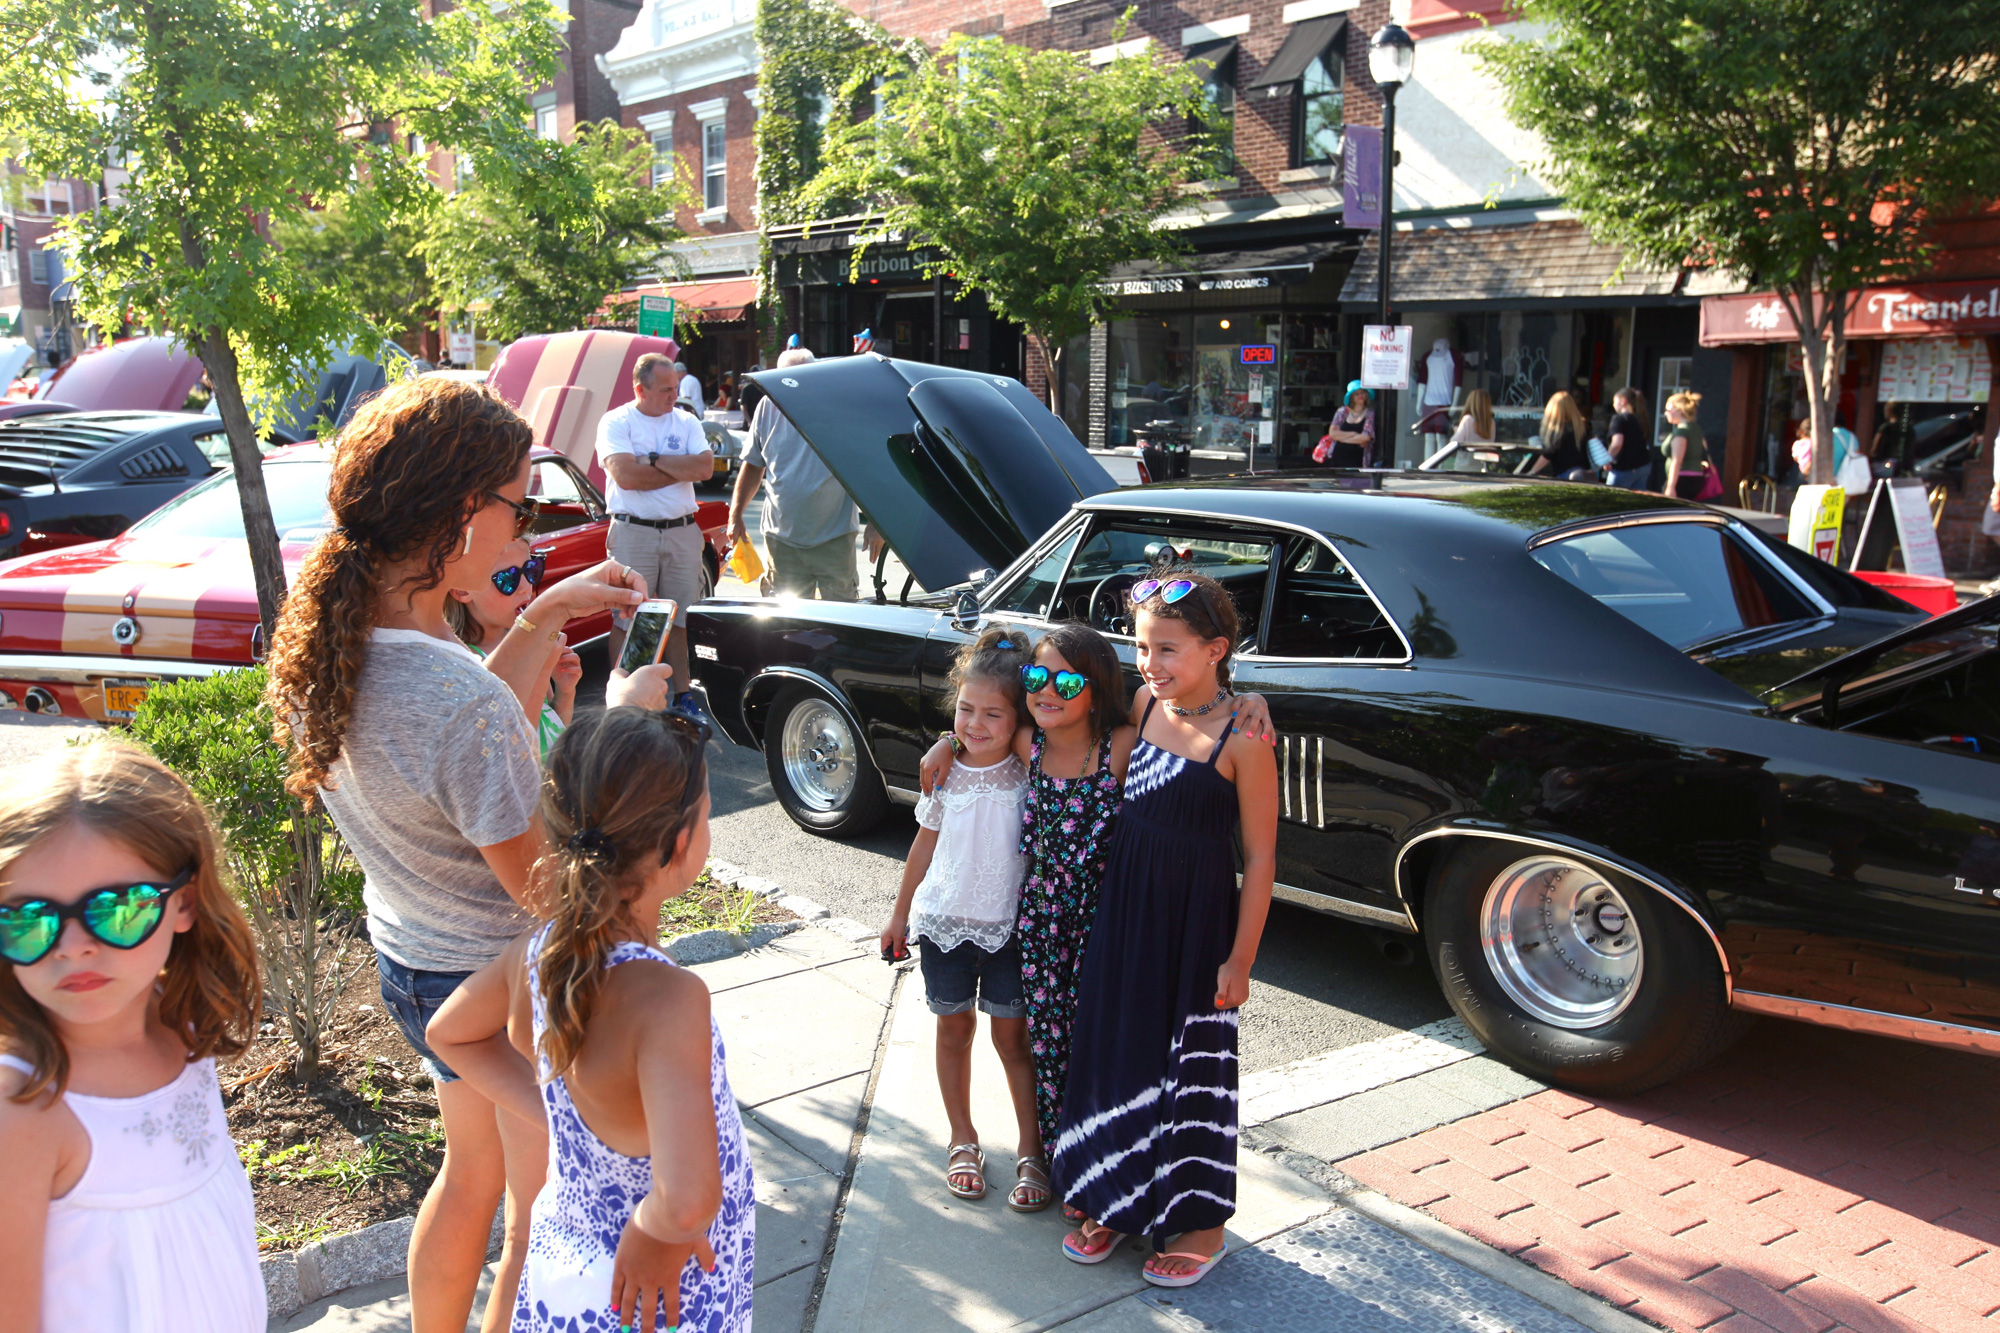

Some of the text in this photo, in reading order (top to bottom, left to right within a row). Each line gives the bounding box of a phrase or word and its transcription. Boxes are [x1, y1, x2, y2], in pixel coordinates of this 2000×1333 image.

[1344, 136, 1359, 201] Music
[1215, 280, 1233, 290] AND
[1233, 277, 1269, 289] COMICS
[1380, 330, 1396, 342] NO
[1243, 348, 1273, 362] OPEN
[1370, 344, 1404, 353] PARKING
